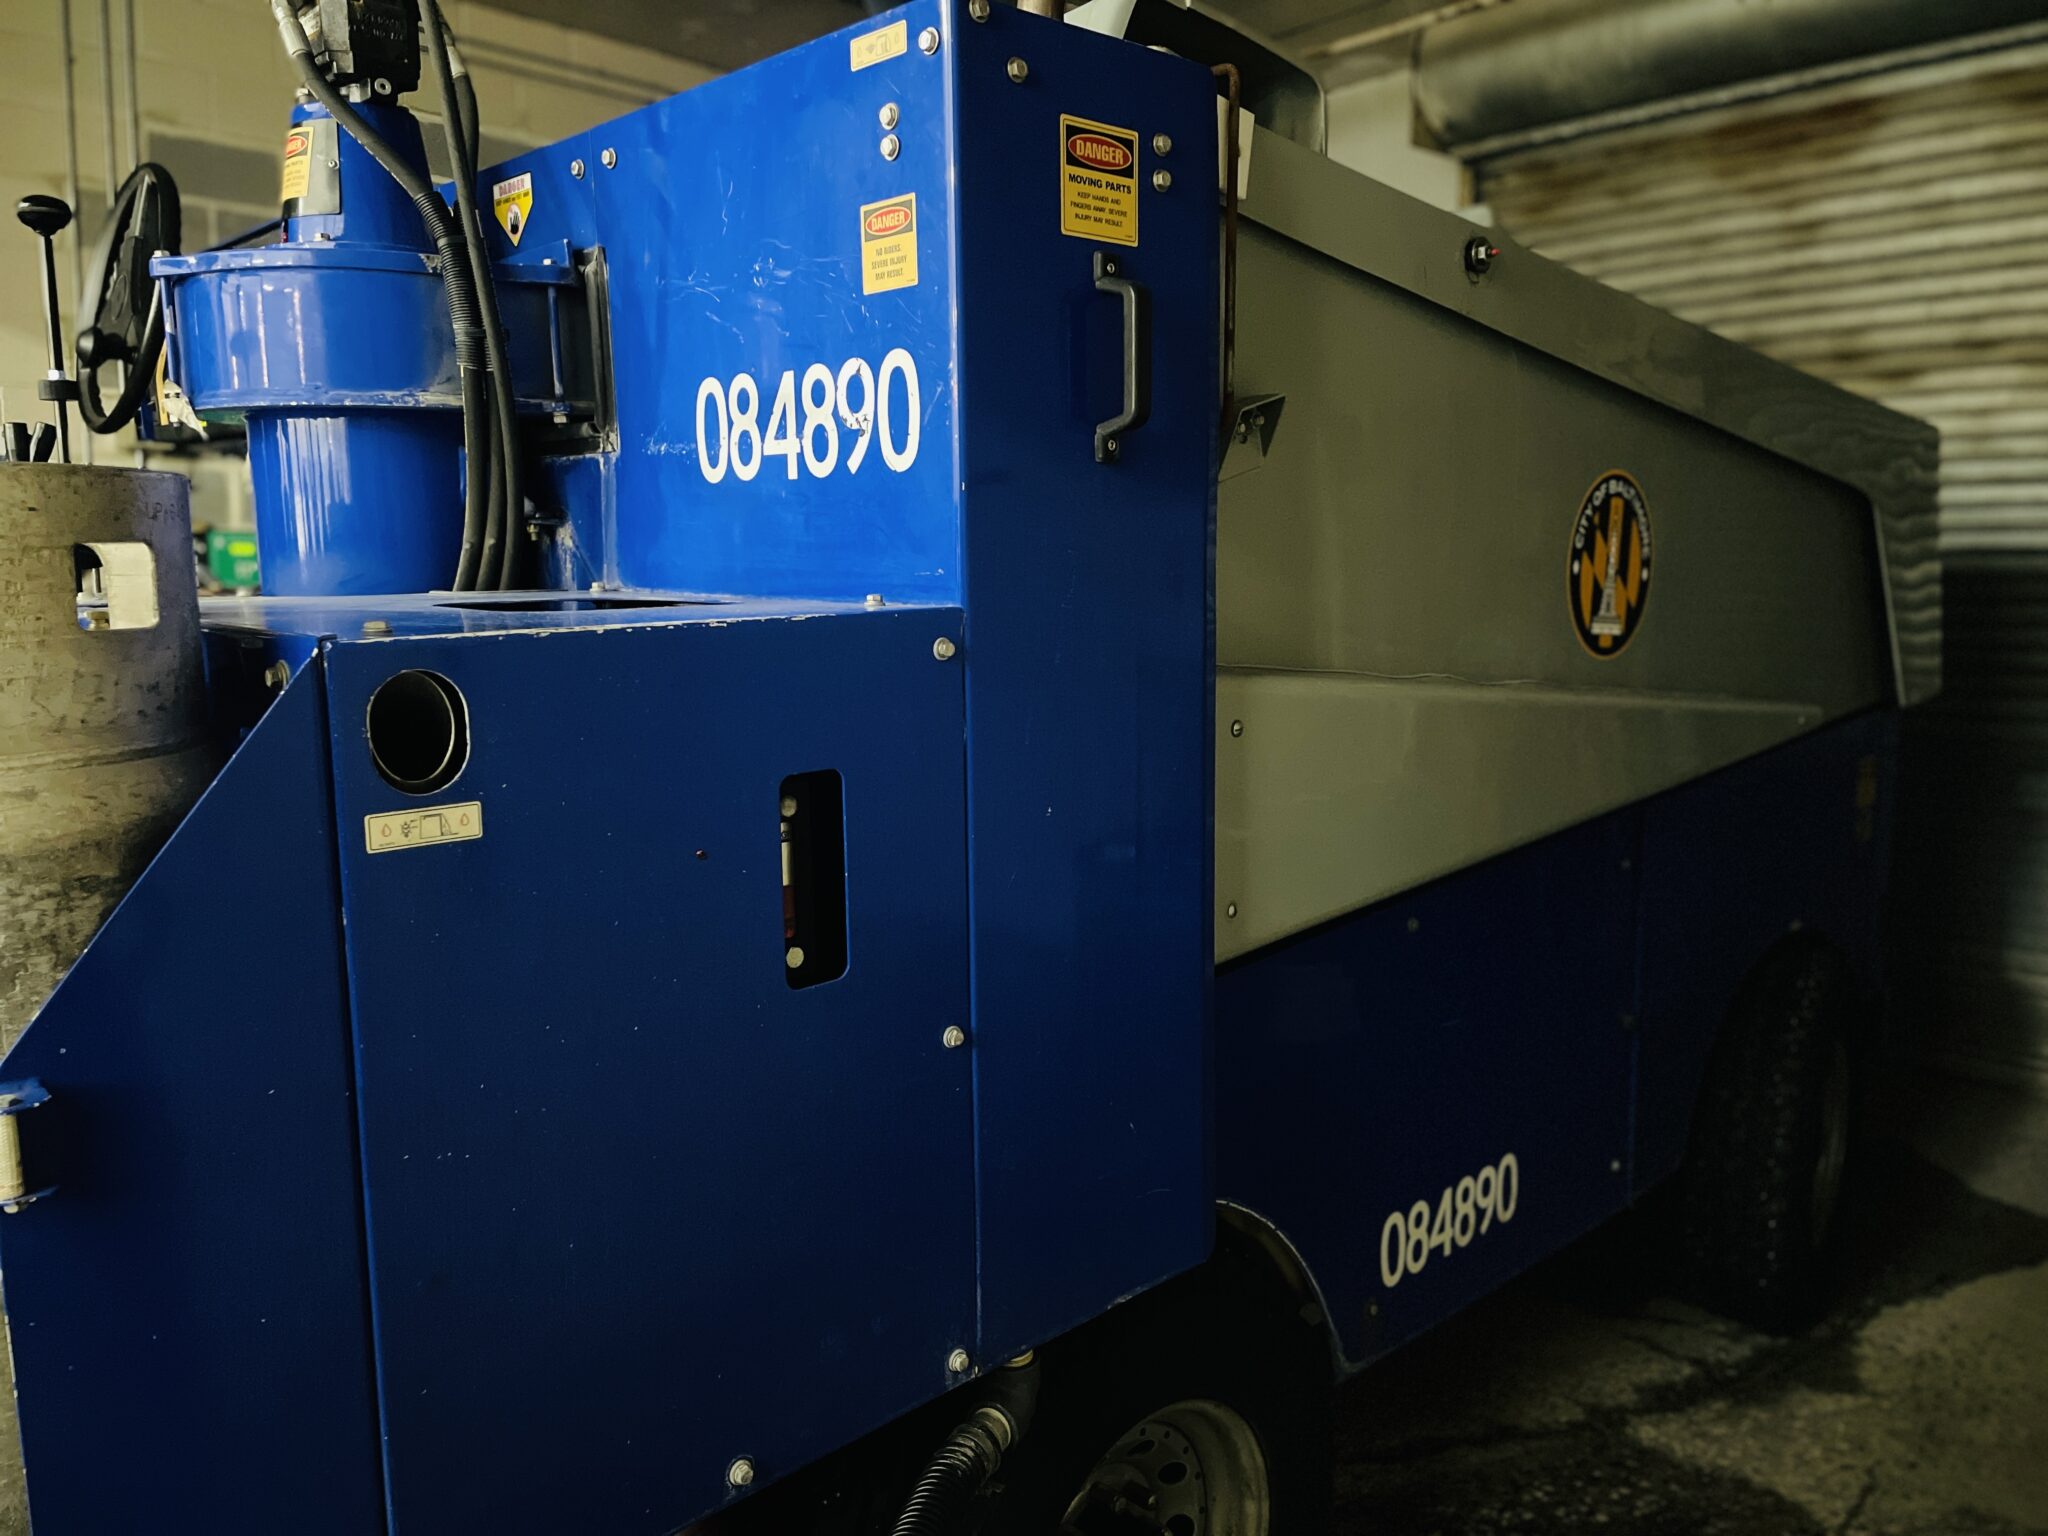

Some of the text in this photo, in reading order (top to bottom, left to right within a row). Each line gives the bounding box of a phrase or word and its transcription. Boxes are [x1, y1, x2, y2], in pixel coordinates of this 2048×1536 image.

[1076, 139, 1124, 165] DANGER
[1068, 172, 1132, 195] MOVING PARTS
[1077, 191, 1122, 206] KEEP HANDS AND
[1070, 200, 1092, 211] FINGERS
[1108, 207, 1128, 218] SEVERE
[1074, 212, 1092, 222] INJURY
[1093, 215, 1104, 224] MAY
[871, 211, 905, 232] DANGER
[875, 247, 883, 256] NO
[871, 254, 908, 271] SEVERE INJURY
[875, 271, 886, 281] MAY
[696, 348, 921, 484] 084890
[1574, 503, 1594, 549] CITY
[1592, 482, 1608, 507] OF
[1380, 1152, 1519, 1288] 084890
